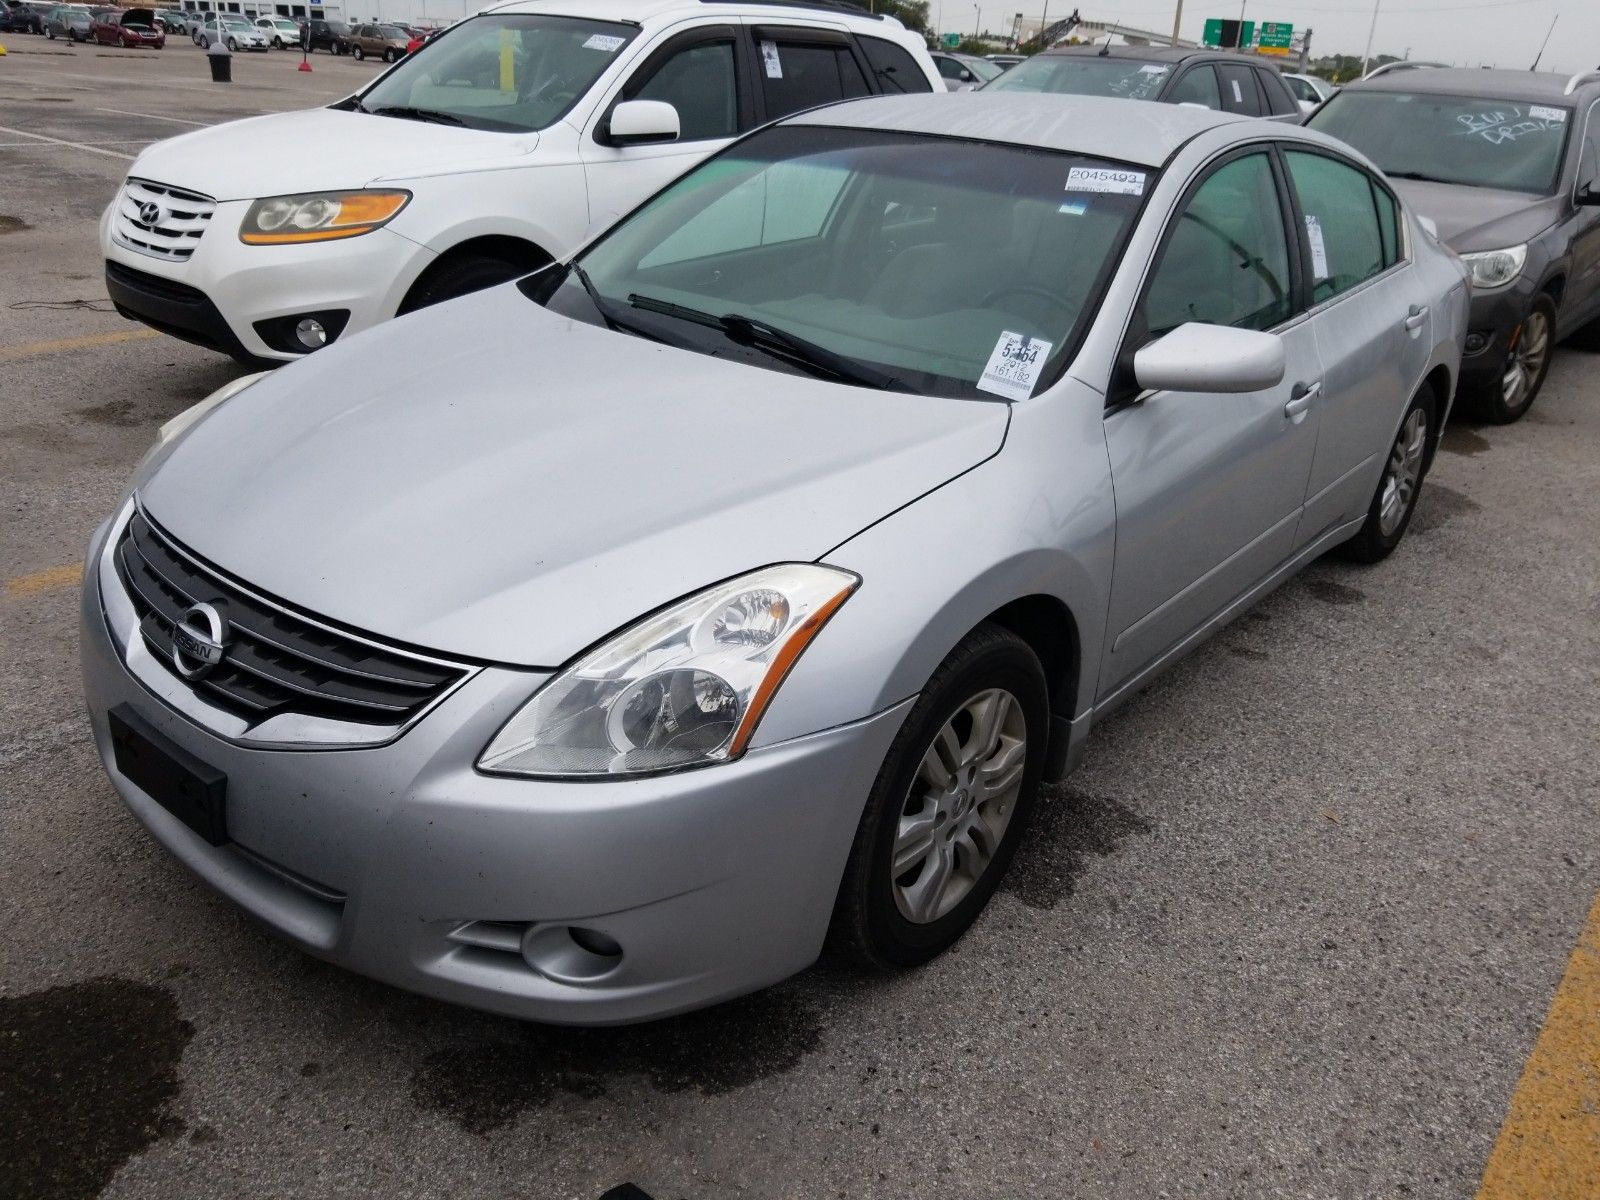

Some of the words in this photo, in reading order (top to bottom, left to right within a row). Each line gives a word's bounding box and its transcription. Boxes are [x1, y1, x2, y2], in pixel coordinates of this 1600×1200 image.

[1070, 170, 1137, 183] 2045493
[1004, 359, 1028, 372] 2012
[175, 630, 212, 659] SSAN
